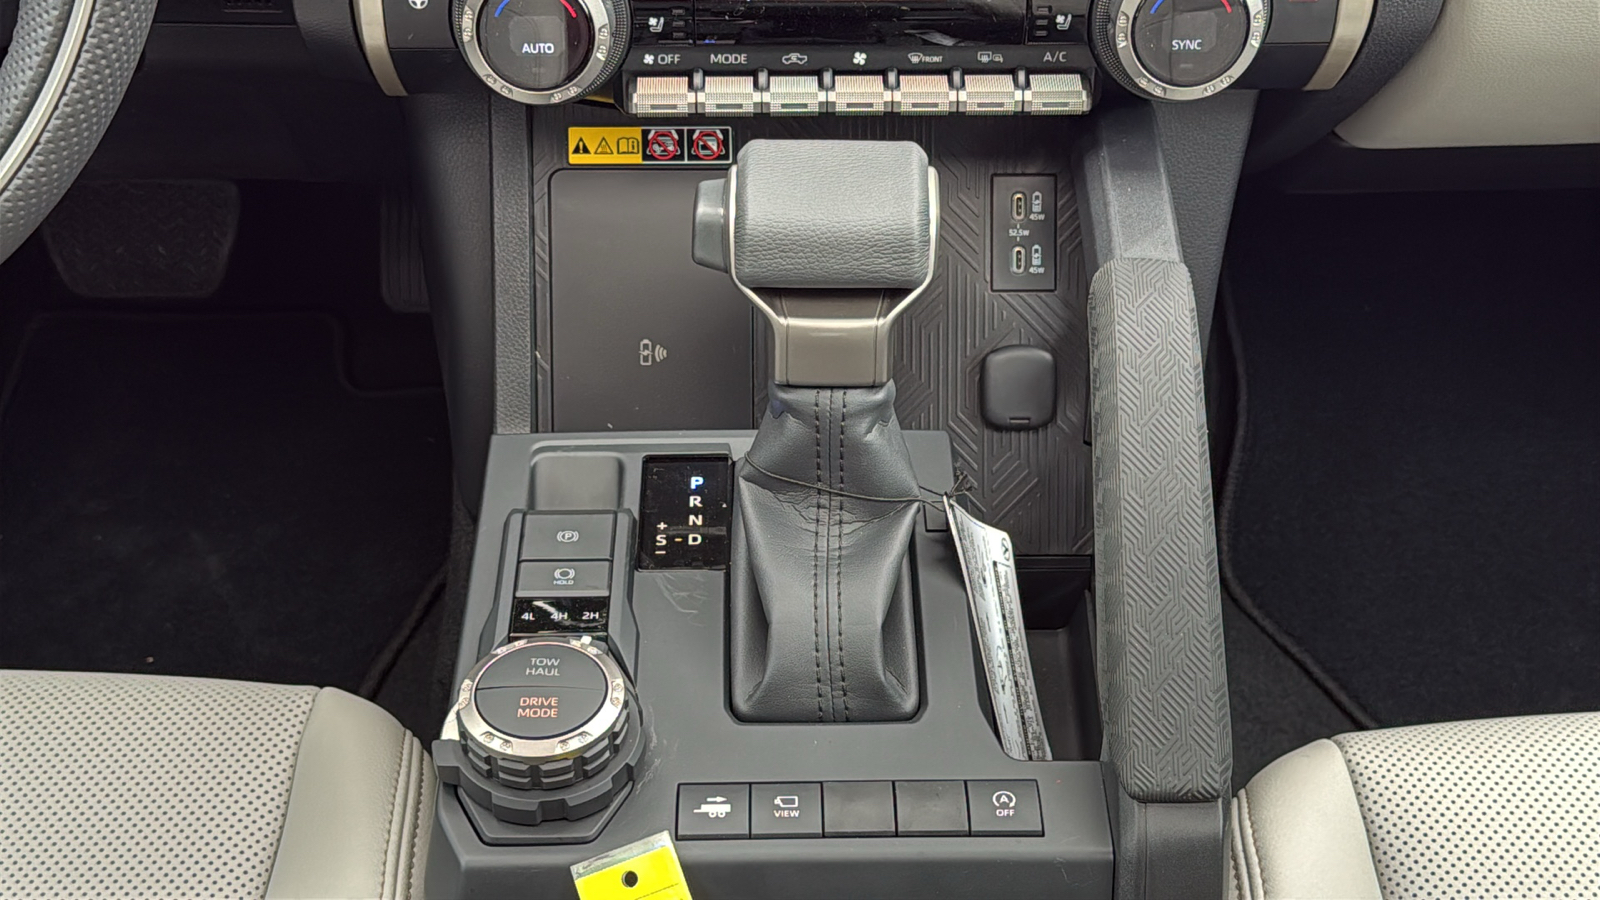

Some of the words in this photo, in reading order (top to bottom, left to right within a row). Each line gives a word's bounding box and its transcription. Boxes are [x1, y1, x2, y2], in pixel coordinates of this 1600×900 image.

[521, 42, 555, 55] AUTO
[1171, 39, 1202, 51] SYNC
[657, 53, 681, 65] OFF
[710, 53, 748, 64] MODE
[922, 55, 943, 63] FRONT
[1043, 51, 1067, 63] A/C
[1029, 213, 1045, 221] 45W
[1008, 229, 1030, 237] 52.5W
[1029, 266, 1045, 274] 45W
[690, 476, 705, 490] P
[689, 495, 703, 508] R
[688, 514, 703, 526] N
[655, 534, 667, 546] S
[688, 533, 702, 546] D
[521, 612, 535, 621] 4L
[550, 612, 568, 621] 4H
[582, 611, 600, 620] 2H
[530, 657, 560, 667] TOW
[525, 667, 560, 676] HAUL
[519, 696, 559, 707] DRIVE
[517, 707, 559, 718] MODE
[773, 809, 800, 818] VIEW
[995, 809, 1015, 818] OFF
